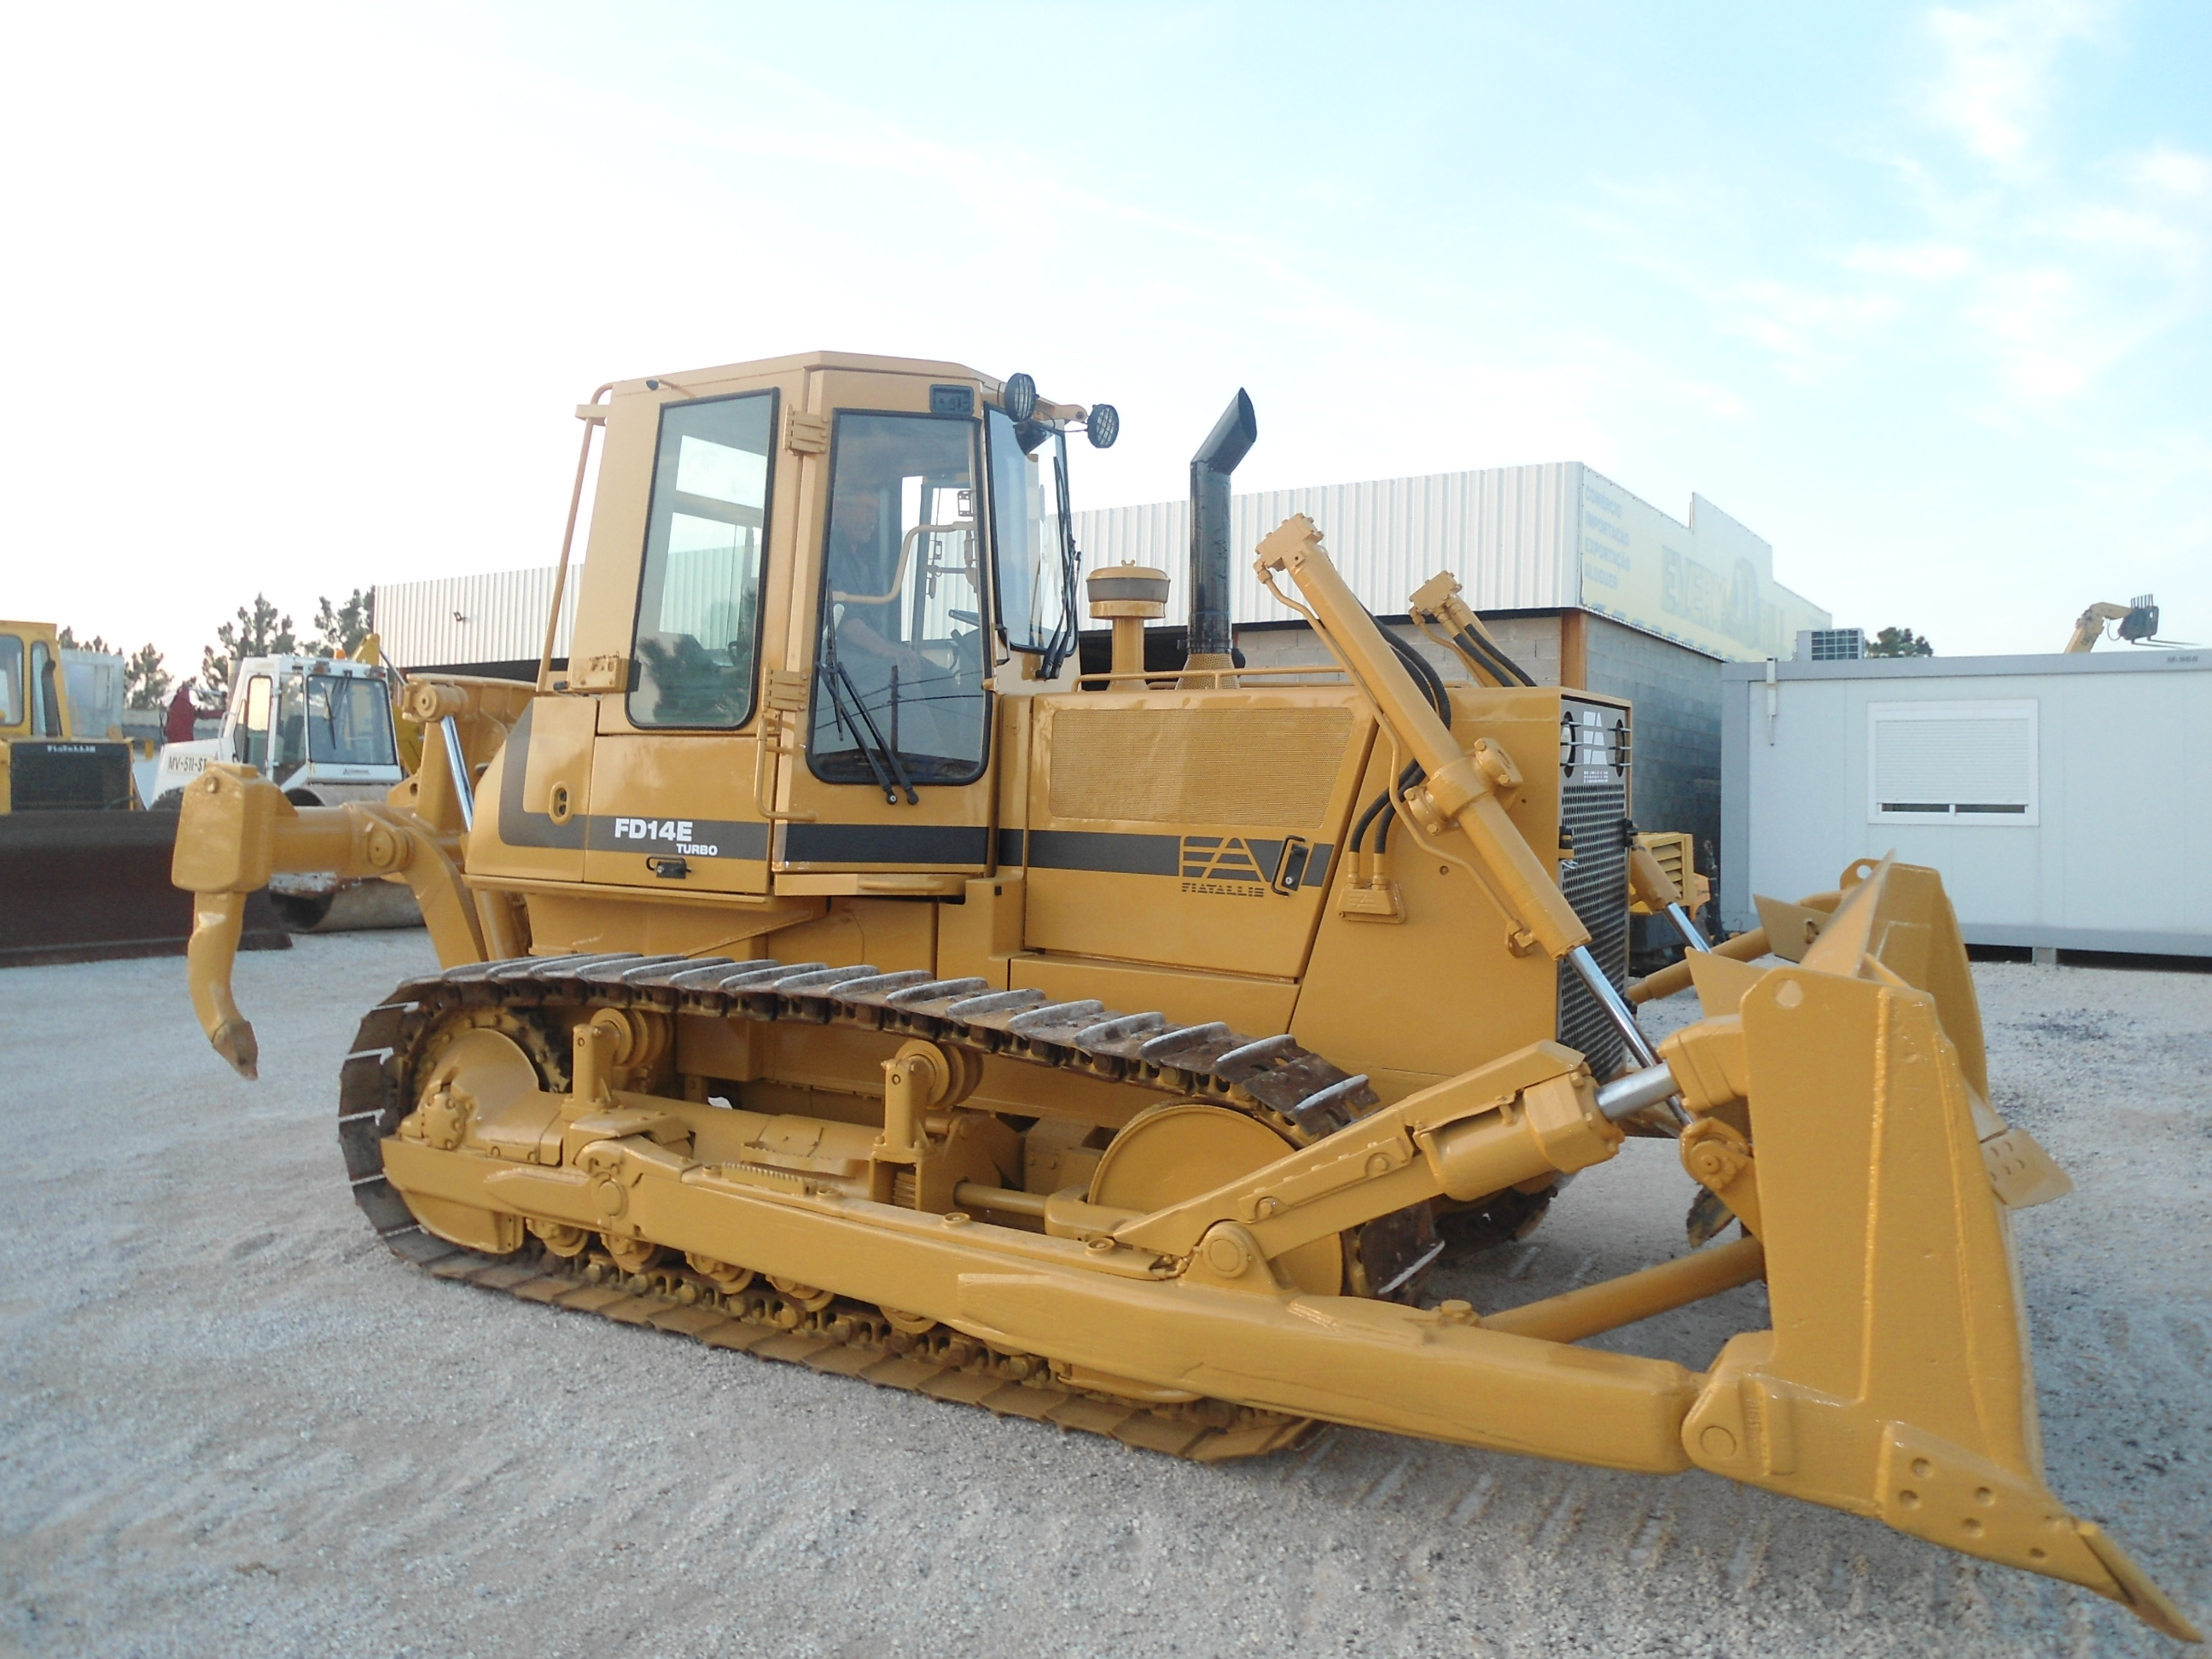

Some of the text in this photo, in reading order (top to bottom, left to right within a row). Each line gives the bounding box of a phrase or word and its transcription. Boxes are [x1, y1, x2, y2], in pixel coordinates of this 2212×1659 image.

[614, 818, 693, 841] FD14E
[676, 842, 719, 856] TURBO
[1182, 882, 1265, 898] FIATALLIS
